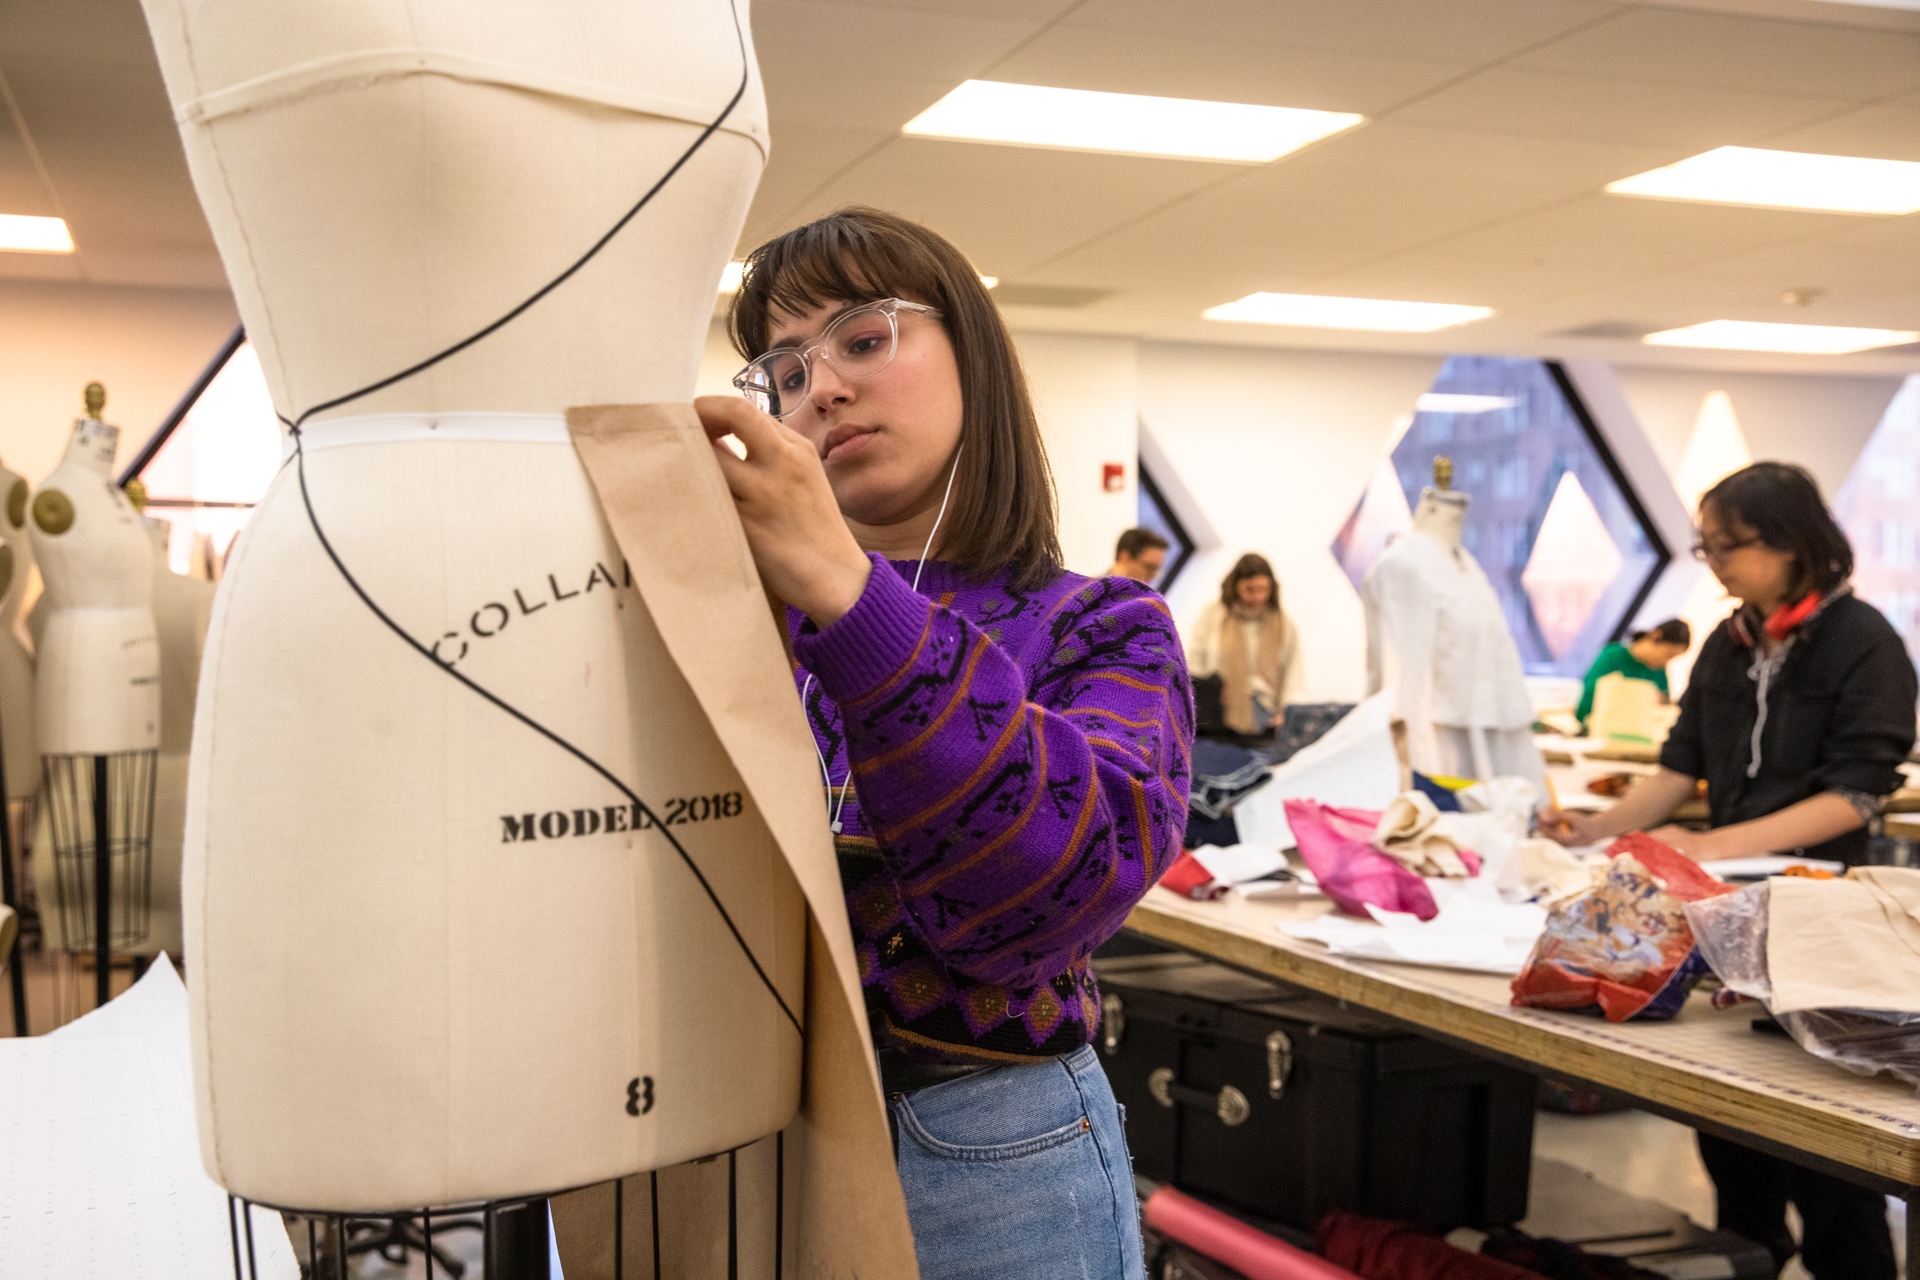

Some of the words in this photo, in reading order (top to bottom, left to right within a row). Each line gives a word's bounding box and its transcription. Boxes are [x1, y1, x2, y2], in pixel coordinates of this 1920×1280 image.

[500, 801, 653, 843] MODEL
[664, 791, 744, 827] 2018
[625, 1075, 655, 1117] 8
